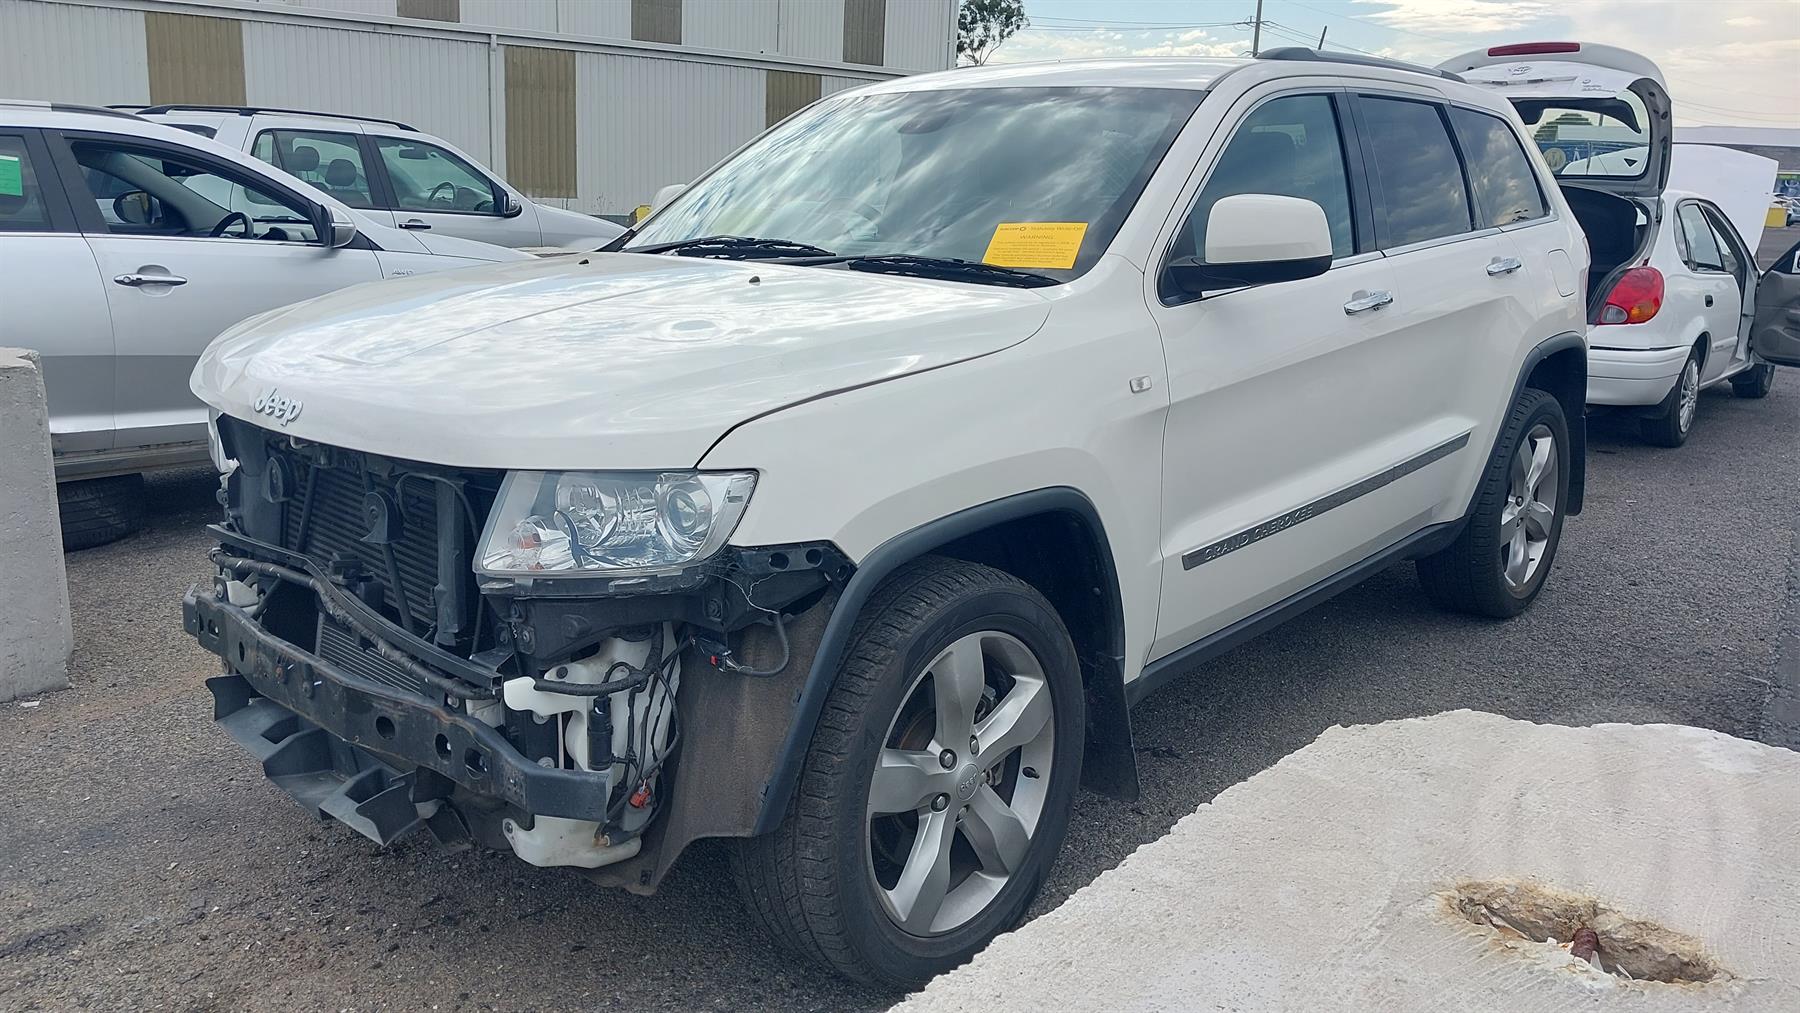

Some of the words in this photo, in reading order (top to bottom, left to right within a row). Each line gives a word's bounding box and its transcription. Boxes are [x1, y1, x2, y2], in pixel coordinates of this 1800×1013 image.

[254, 387, 303, 427] Jeep
[1204, 534, 1249, 561] GRAND
[1253, 505, 1313, 540] CHEROKEE
